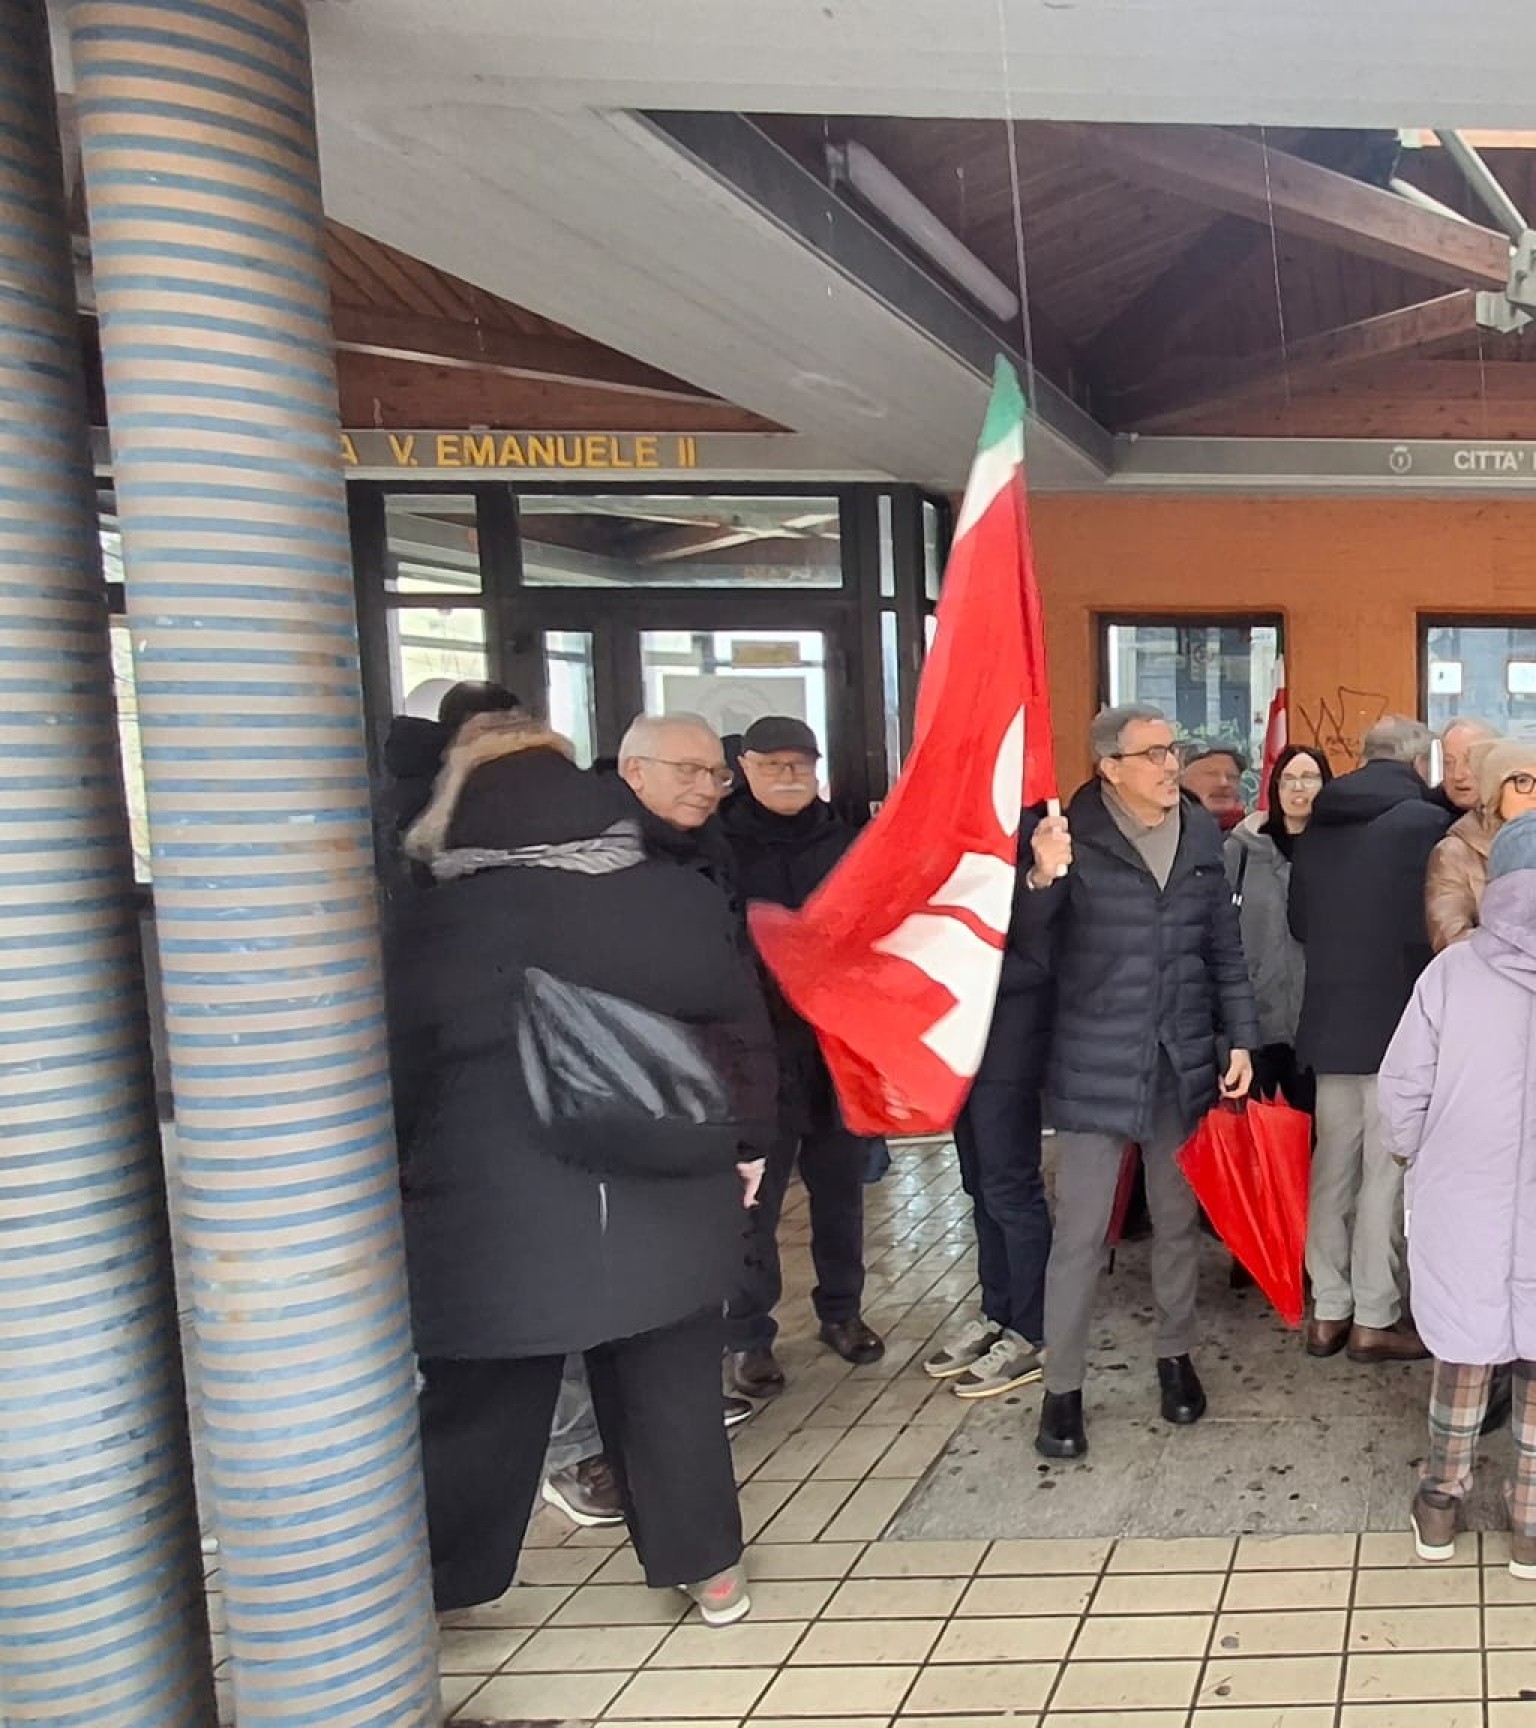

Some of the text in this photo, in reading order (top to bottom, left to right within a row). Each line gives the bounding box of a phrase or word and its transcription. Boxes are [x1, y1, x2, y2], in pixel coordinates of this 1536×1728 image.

[388, 434, 418, 466] V.
[436, 435, 659, 468] EMANUELE
[678, 438, 696, 468] II
[1454, 450, 1525, 471] CITTA'
